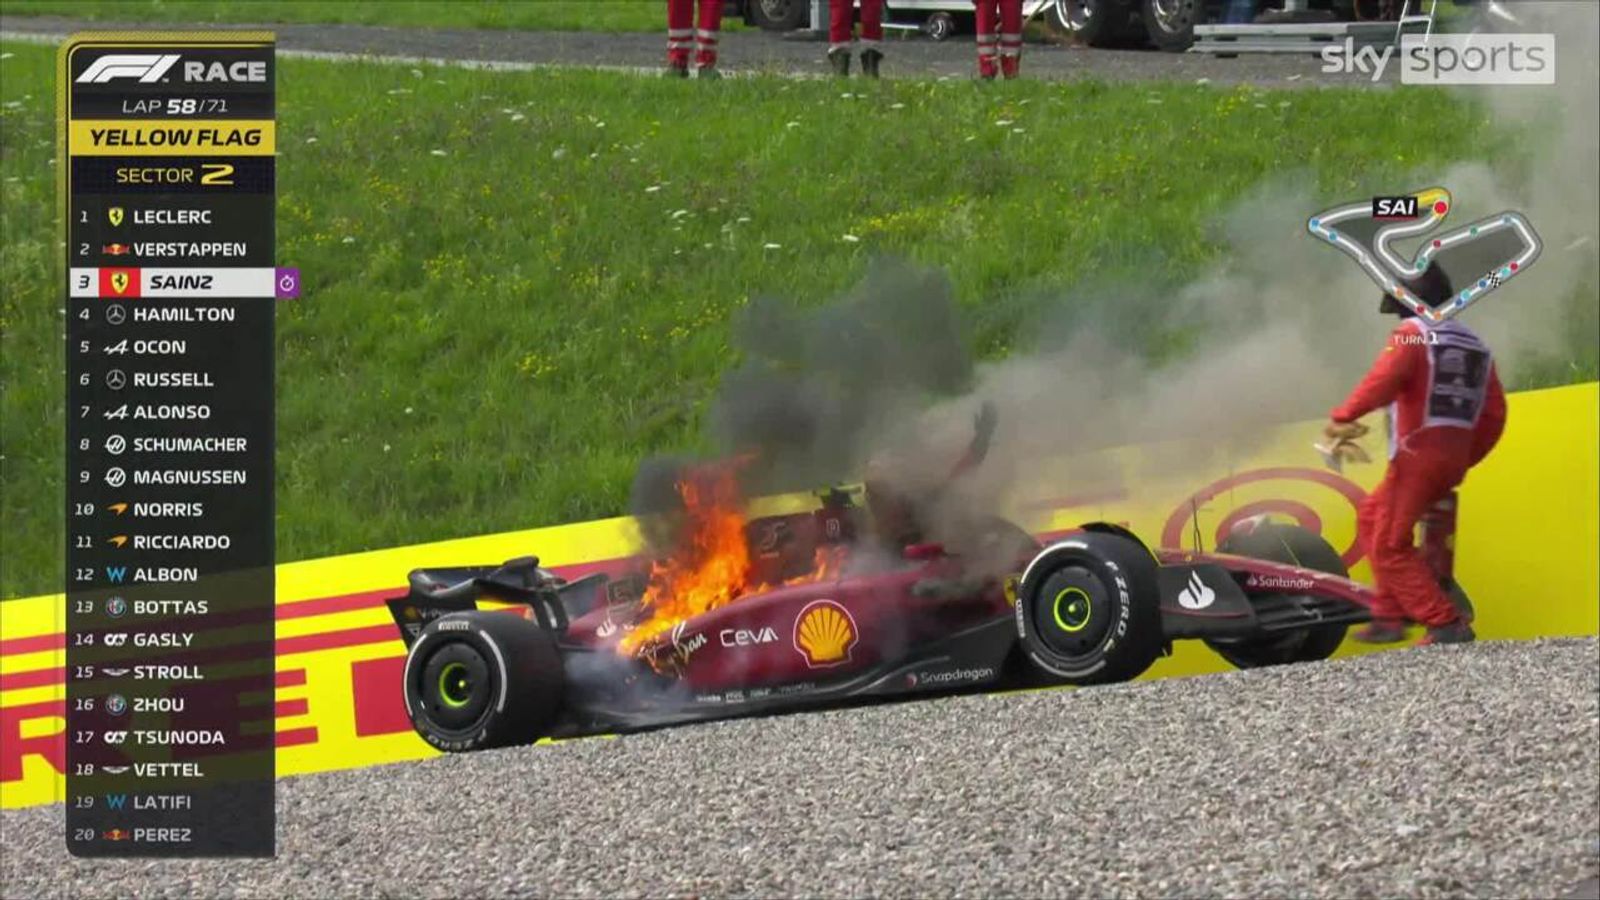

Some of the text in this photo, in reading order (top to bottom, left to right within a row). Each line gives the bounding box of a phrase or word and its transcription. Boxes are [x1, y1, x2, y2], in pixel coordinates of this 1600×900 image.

[1258, 574, 1316, 589] Santander
[1114, 575, 1131, 637] ZERO
[920, 667, 994, 684] Snapdragon
